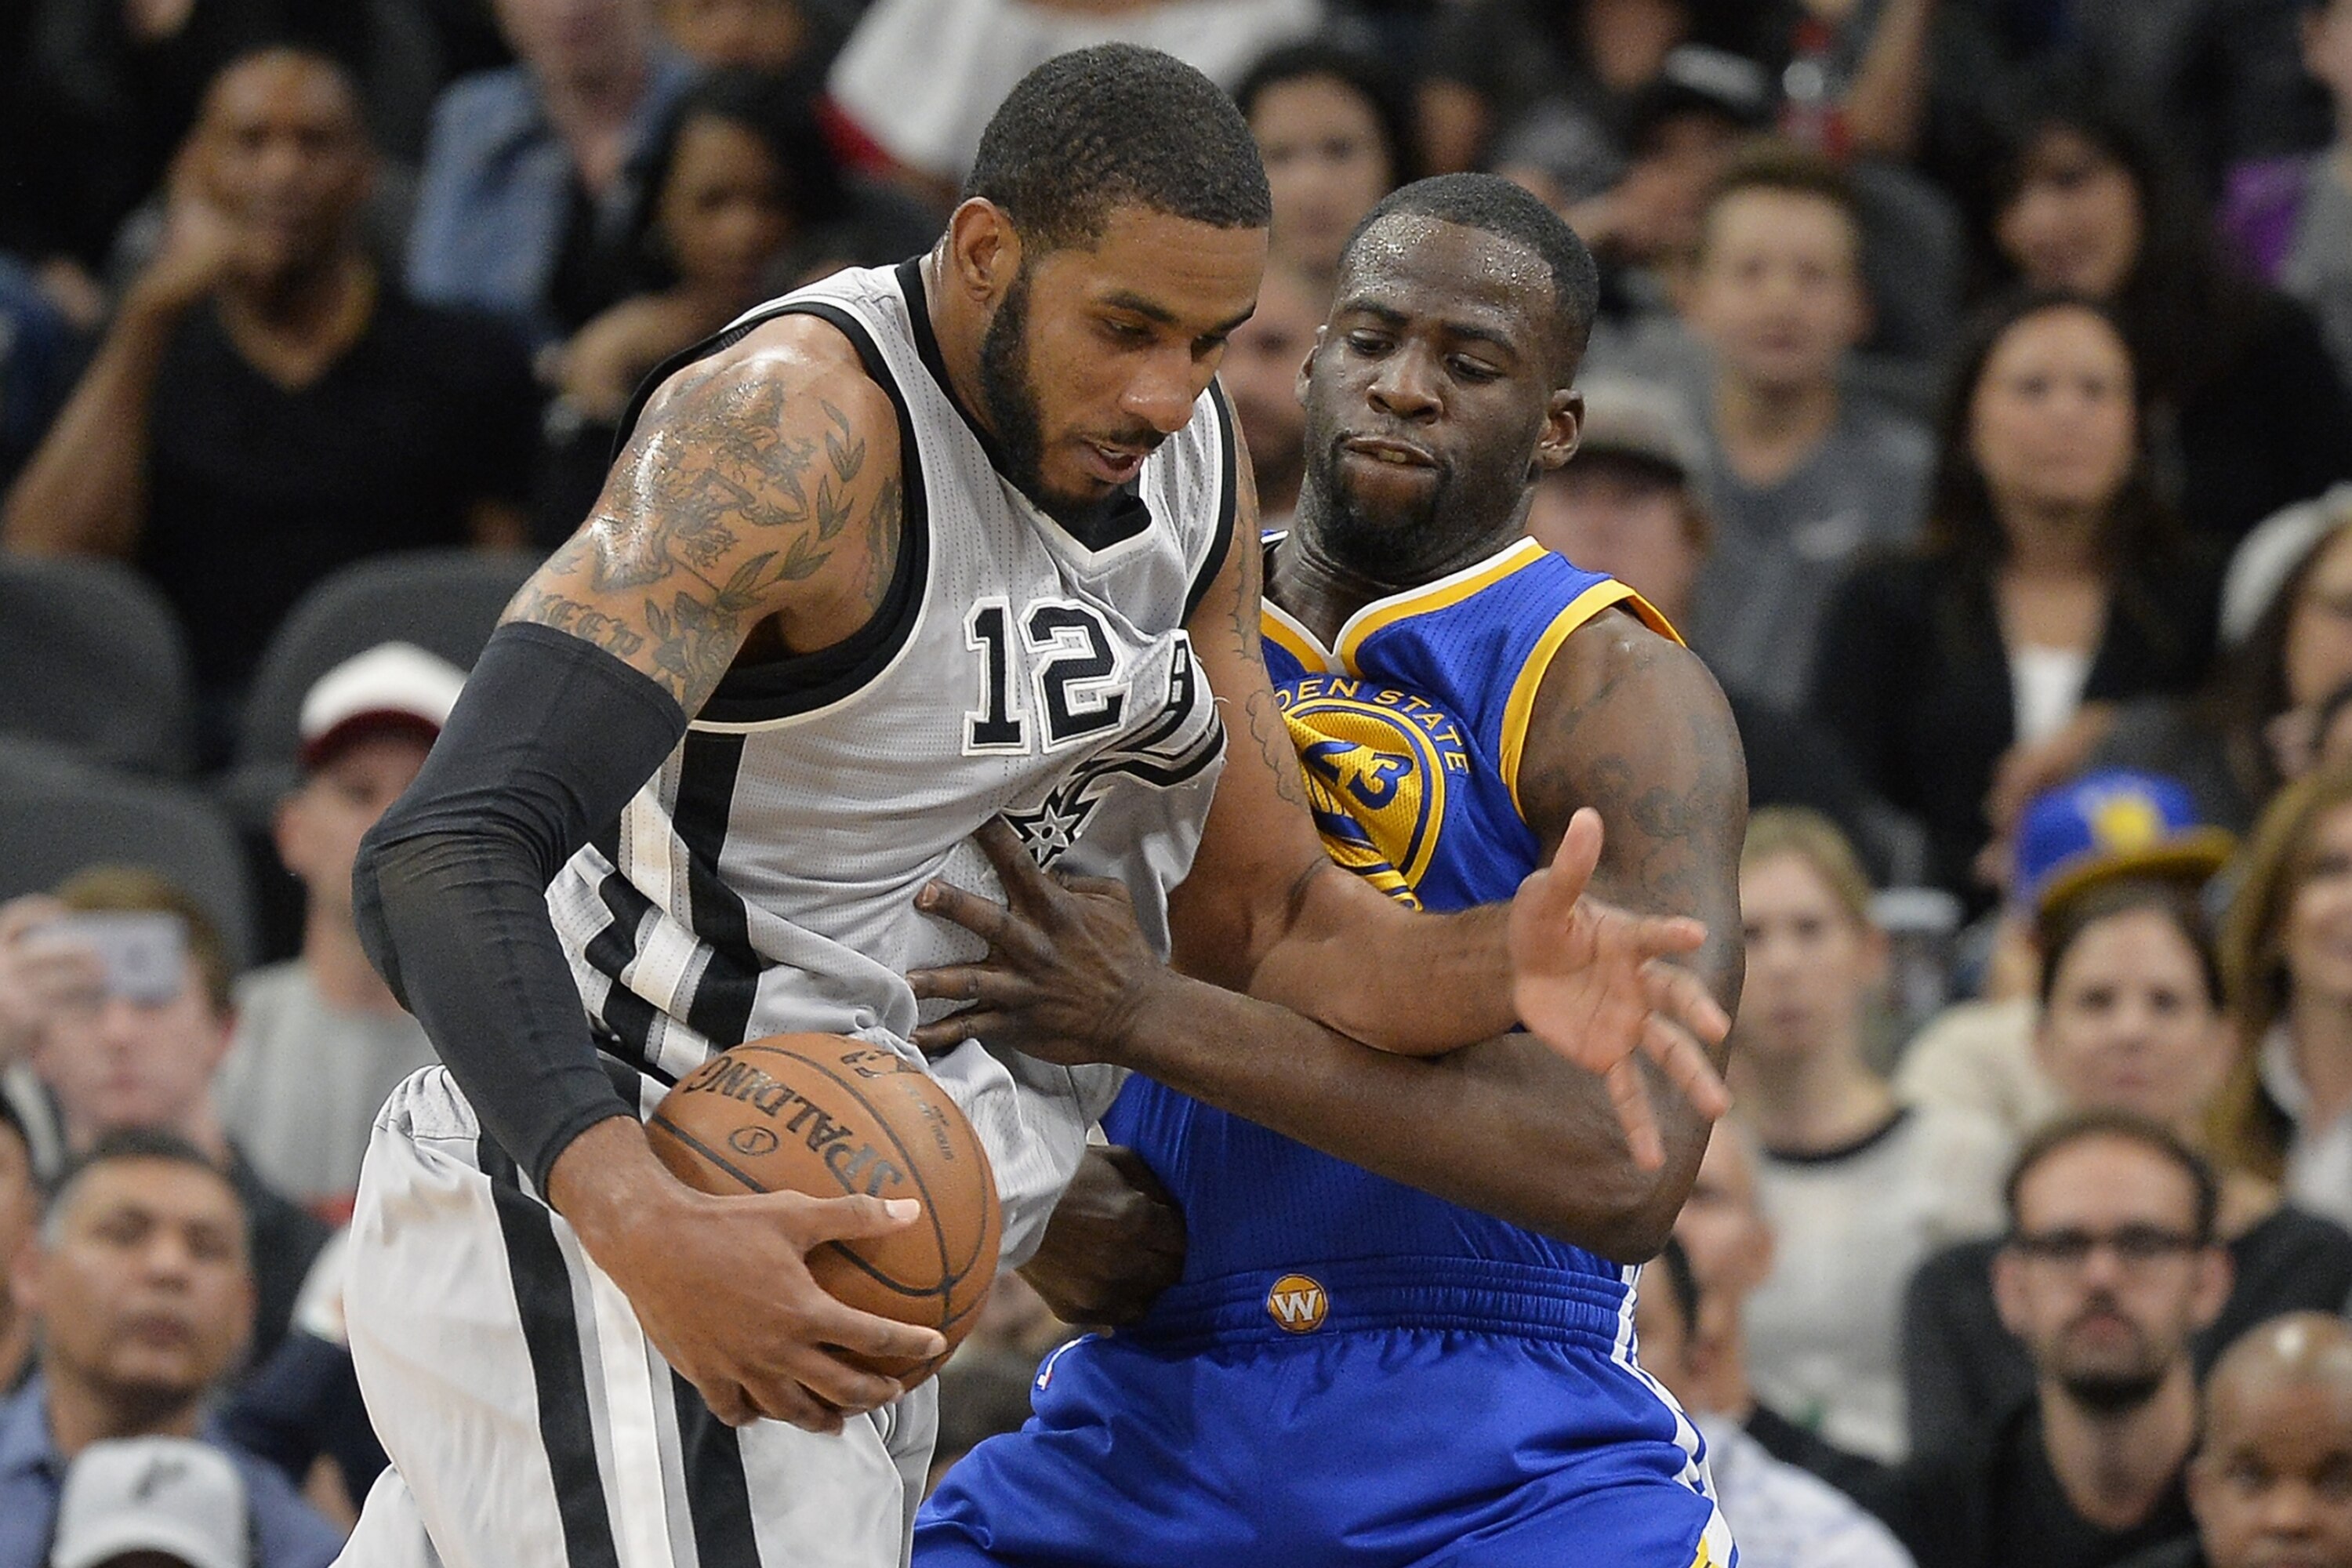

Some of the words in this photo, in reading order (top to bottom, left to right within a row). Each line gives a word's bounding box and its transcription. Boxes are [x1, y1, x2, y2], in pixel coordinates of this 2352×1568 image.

[963, 596, 1132, 755] 12
[1275, 678, 1359, 711] DEN
[1374, 689, 1472, 774] STATE
[683, 1055, 905, 1198] SPALDING
[1272, 1289, 1321, 1323] W
